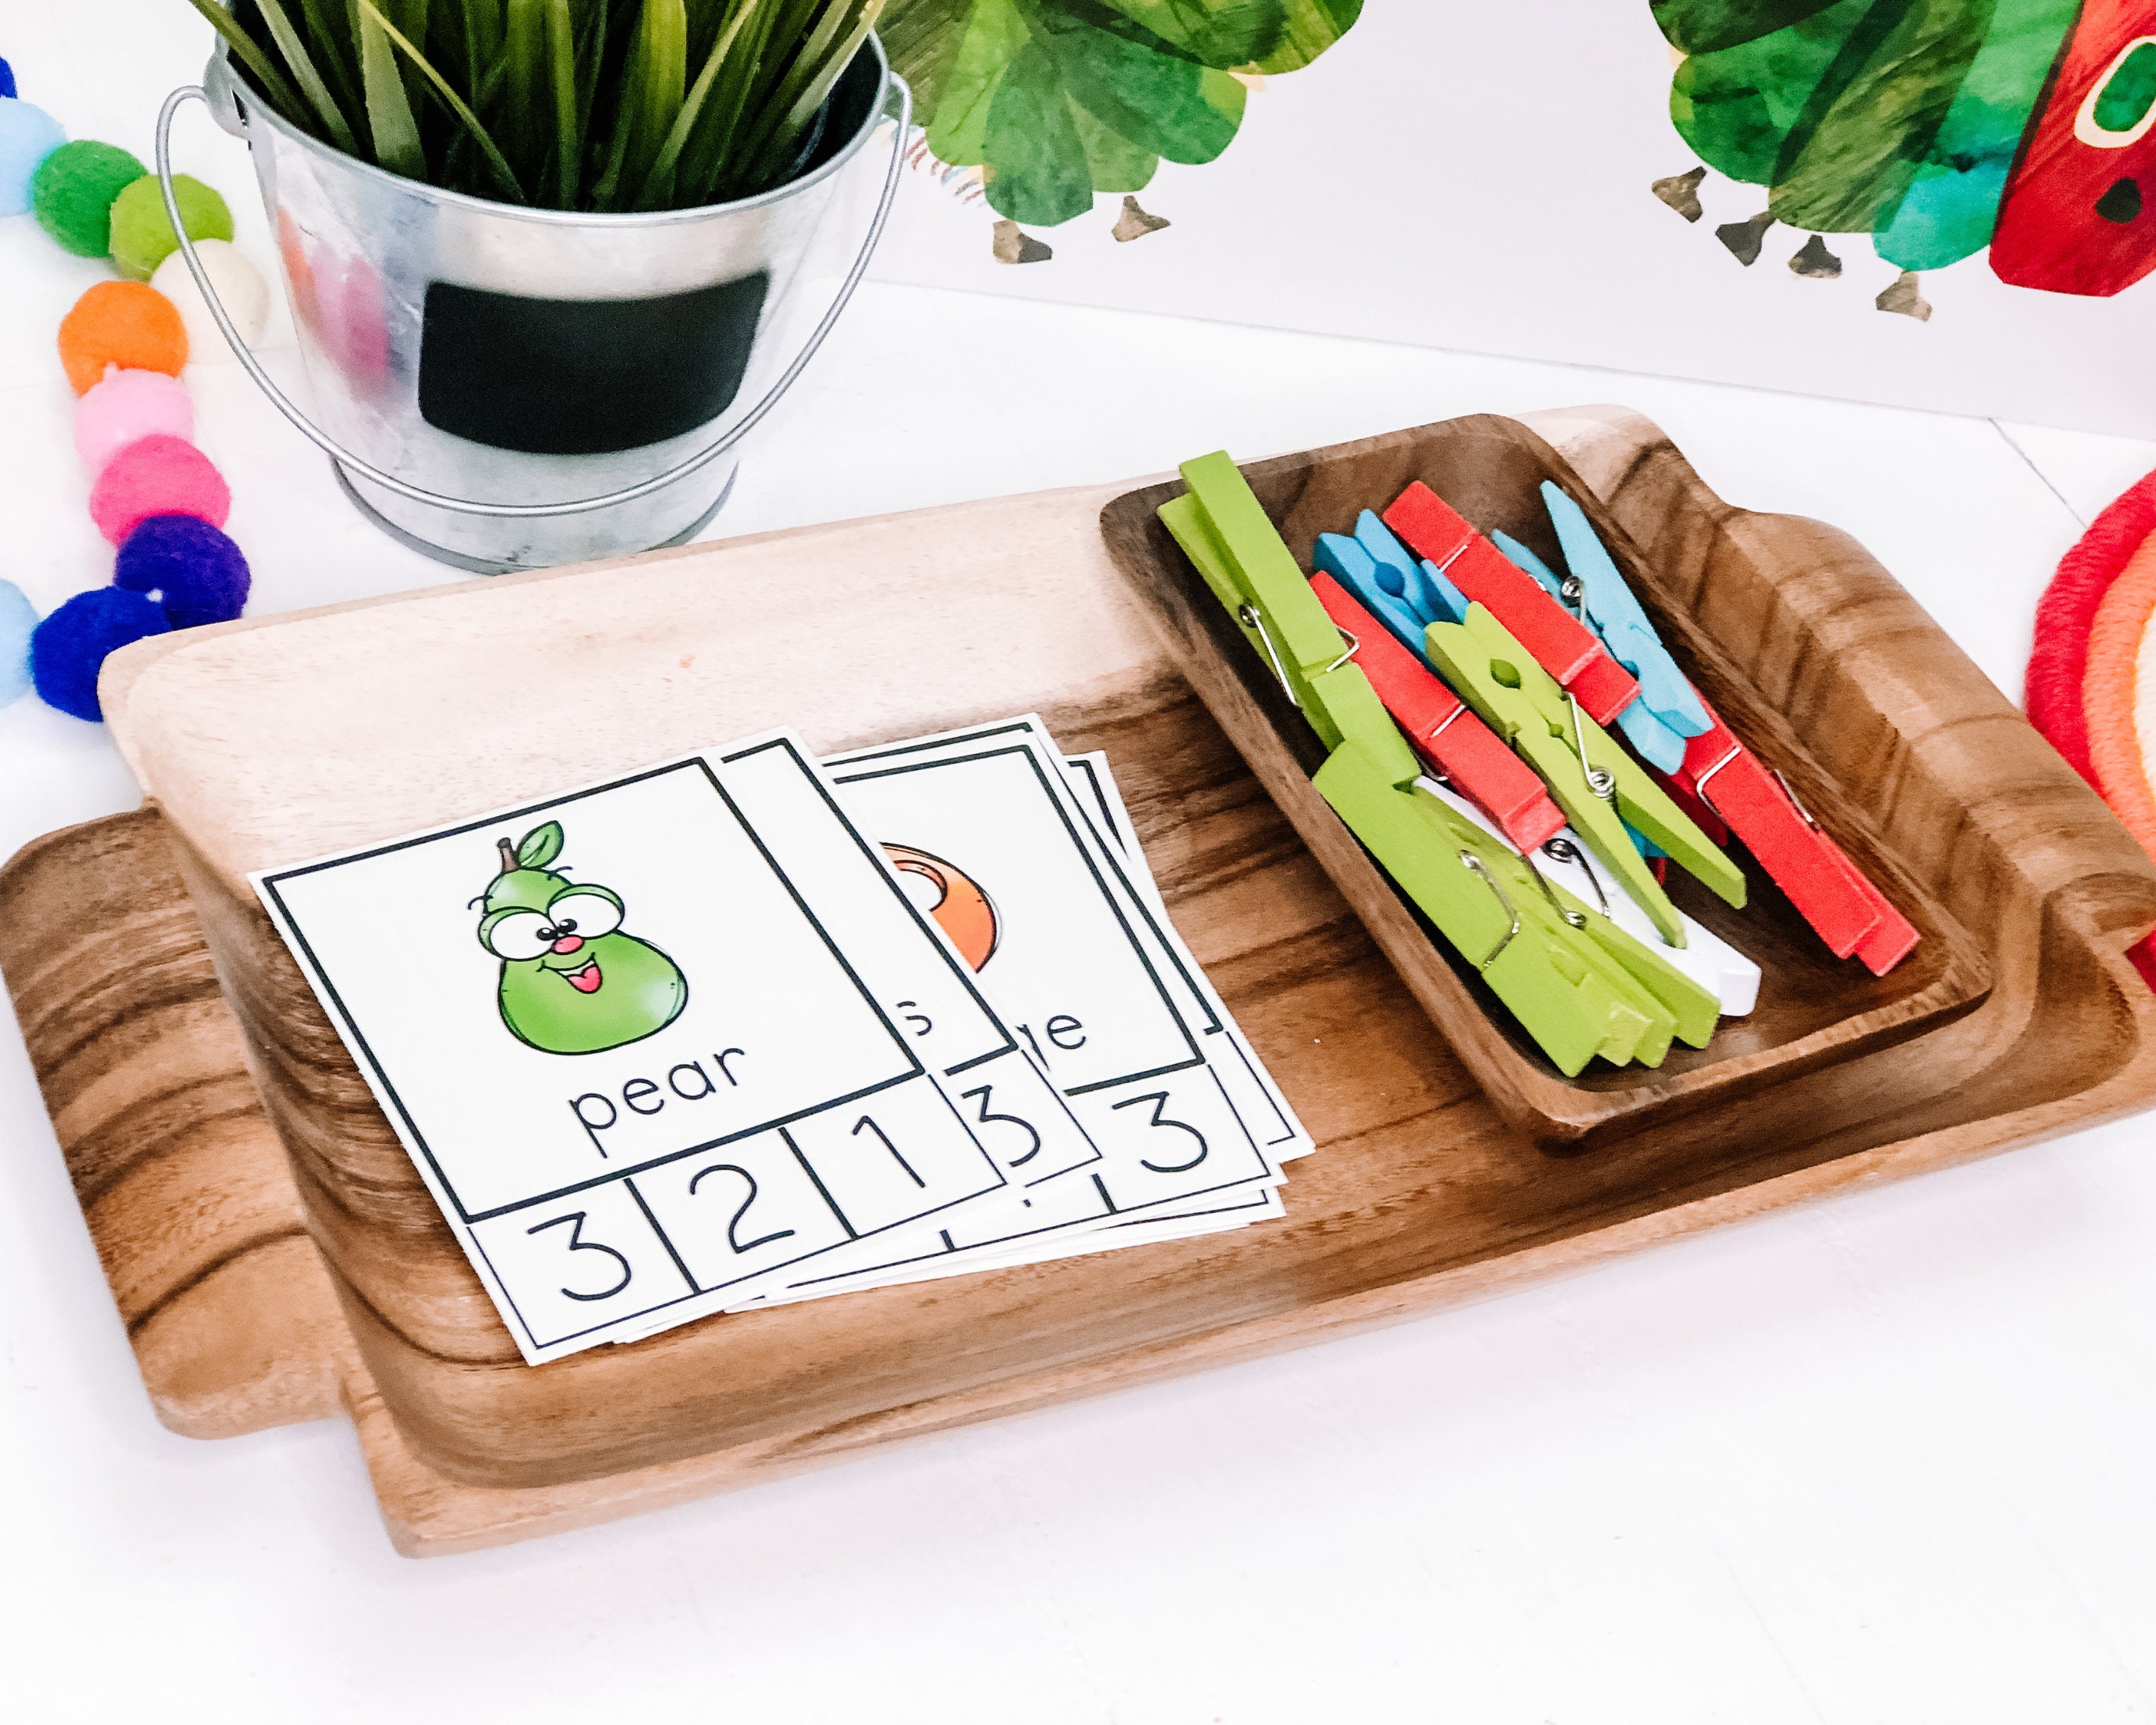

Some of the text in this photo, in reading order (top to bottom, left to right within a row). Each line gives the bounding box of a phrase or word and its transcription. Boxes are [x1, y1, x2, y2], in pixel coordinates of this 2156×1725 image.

[567, 1047, 746, 1160] pear
[960, 1084, 1042, 1169] 3
[1110, 1090, 1209, 1175] 3
[526, 1114, 927, 1302] 3 2 1
